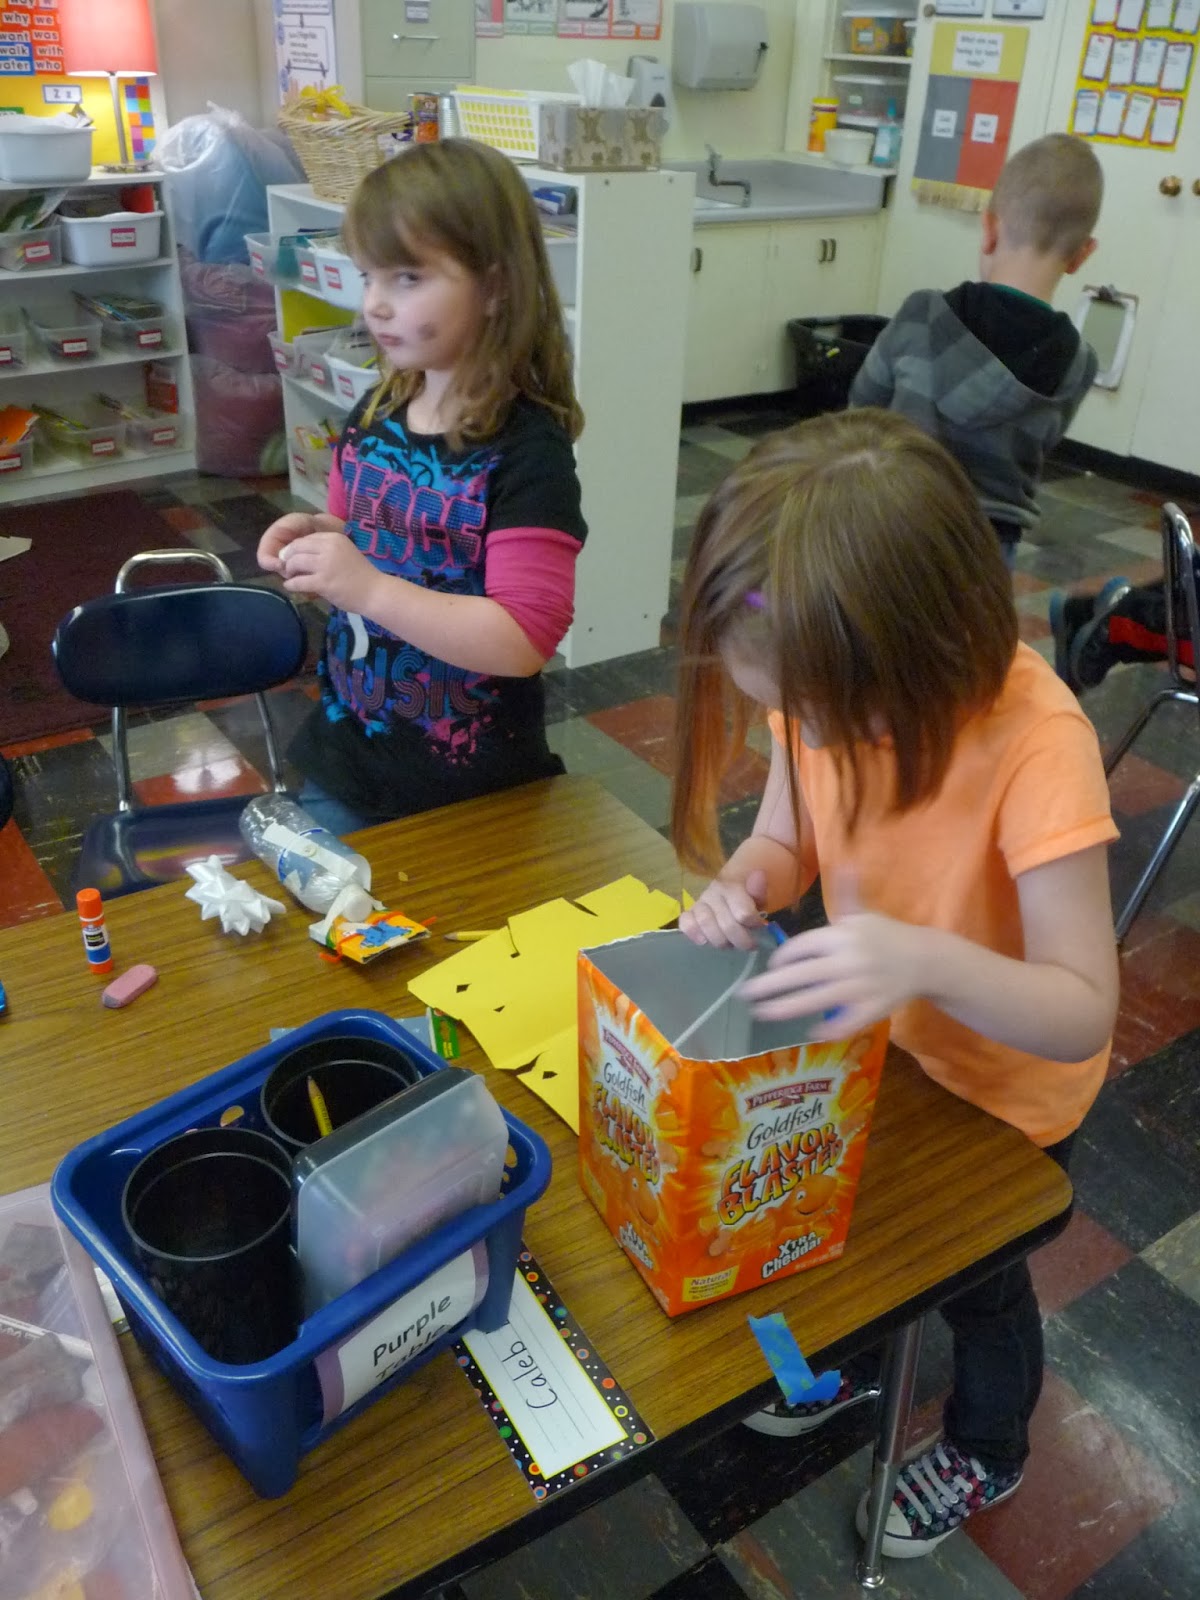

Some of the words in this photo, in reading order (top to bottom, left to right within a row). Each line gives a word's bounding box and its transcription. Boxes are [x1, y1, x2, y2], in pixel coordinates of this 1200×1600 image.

[4, 12, 28, 25] why
[35, 16, 53, 24] we
[0, 32, 28, 41] want
[33, 31, 58, 40] was
[0, 46, 28, 55] walk
[38, 46, 64, 56] with
[0, 61, 29, 70] ater
[35, 60, 61, 70] who
[603, 1062, 645, 1108] Goldfish
[752, 1083, 804, 1107] PEPPERIDGE
[805, 1081, 828, 1095] FARM
[594, 1081, 656, 1158] FLAVOR
[747, 1098, 822, 1150] Goldfish
[722, 1122, 839, 1198] FLAVOR
[717, 1139, 844, 1225] BLASTED
[761, 1237, 823, 1280] Cheddar
[690, 1268, 732, 1286] Natural
[373, 1295, 452, 1367] Purple
[501, 1340, 558, 1409] Caleb
